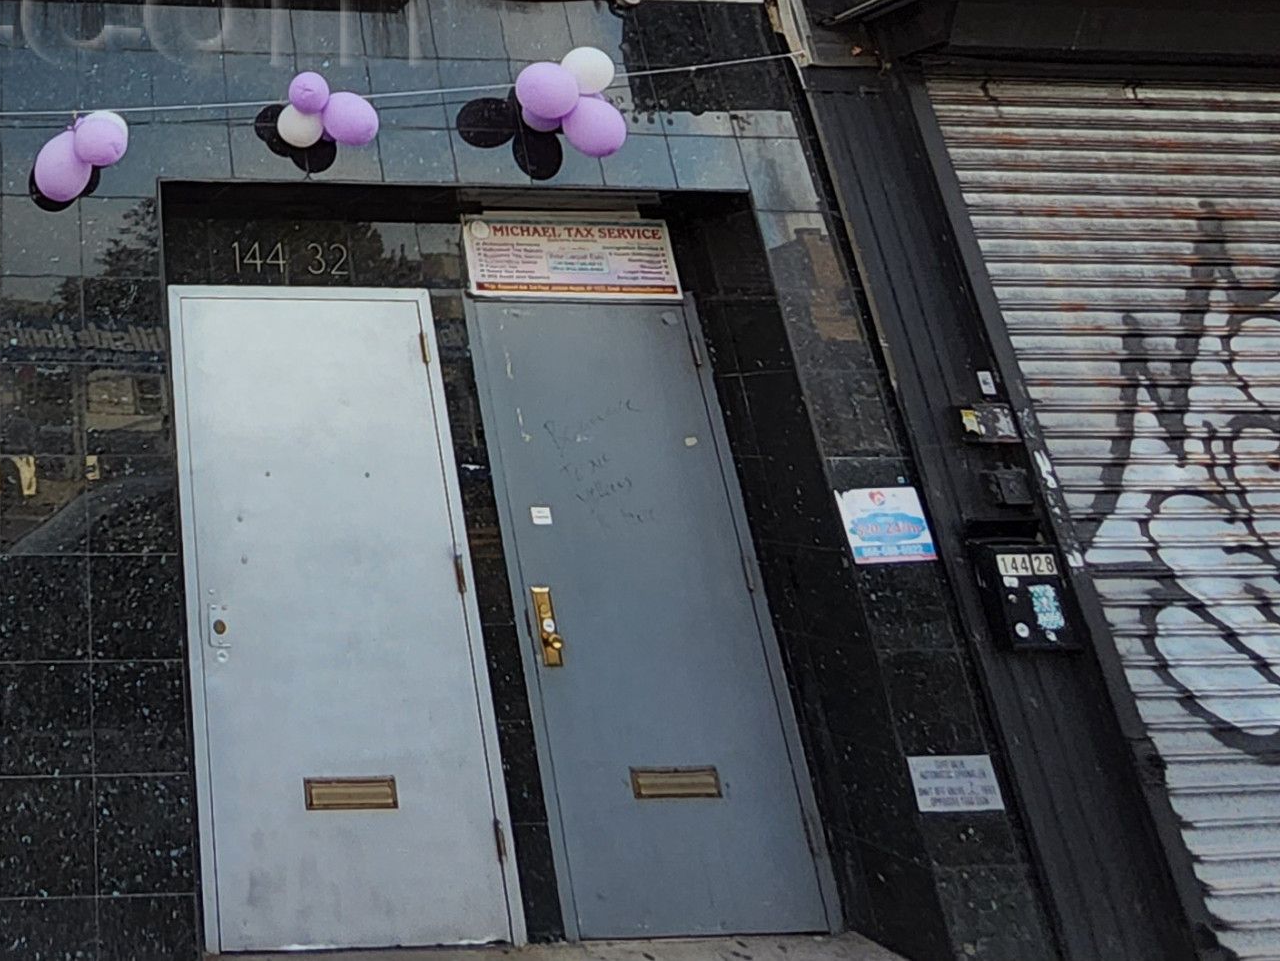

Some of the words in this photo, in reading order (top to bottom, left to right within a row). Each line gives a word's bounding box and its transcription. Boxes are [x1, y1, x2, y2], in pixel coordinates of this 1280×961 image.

[492, 225, 561, 238] MICHAEL
[564, 227, 595, 239] TAX
[597, 227, 663, 241] SERVICE
[231, 241, 287, 274] 144
[307, 242, 349, 276] 32
[1001, 555, 1029, 575] 144
[1033, 555, 1055, 574] 28
